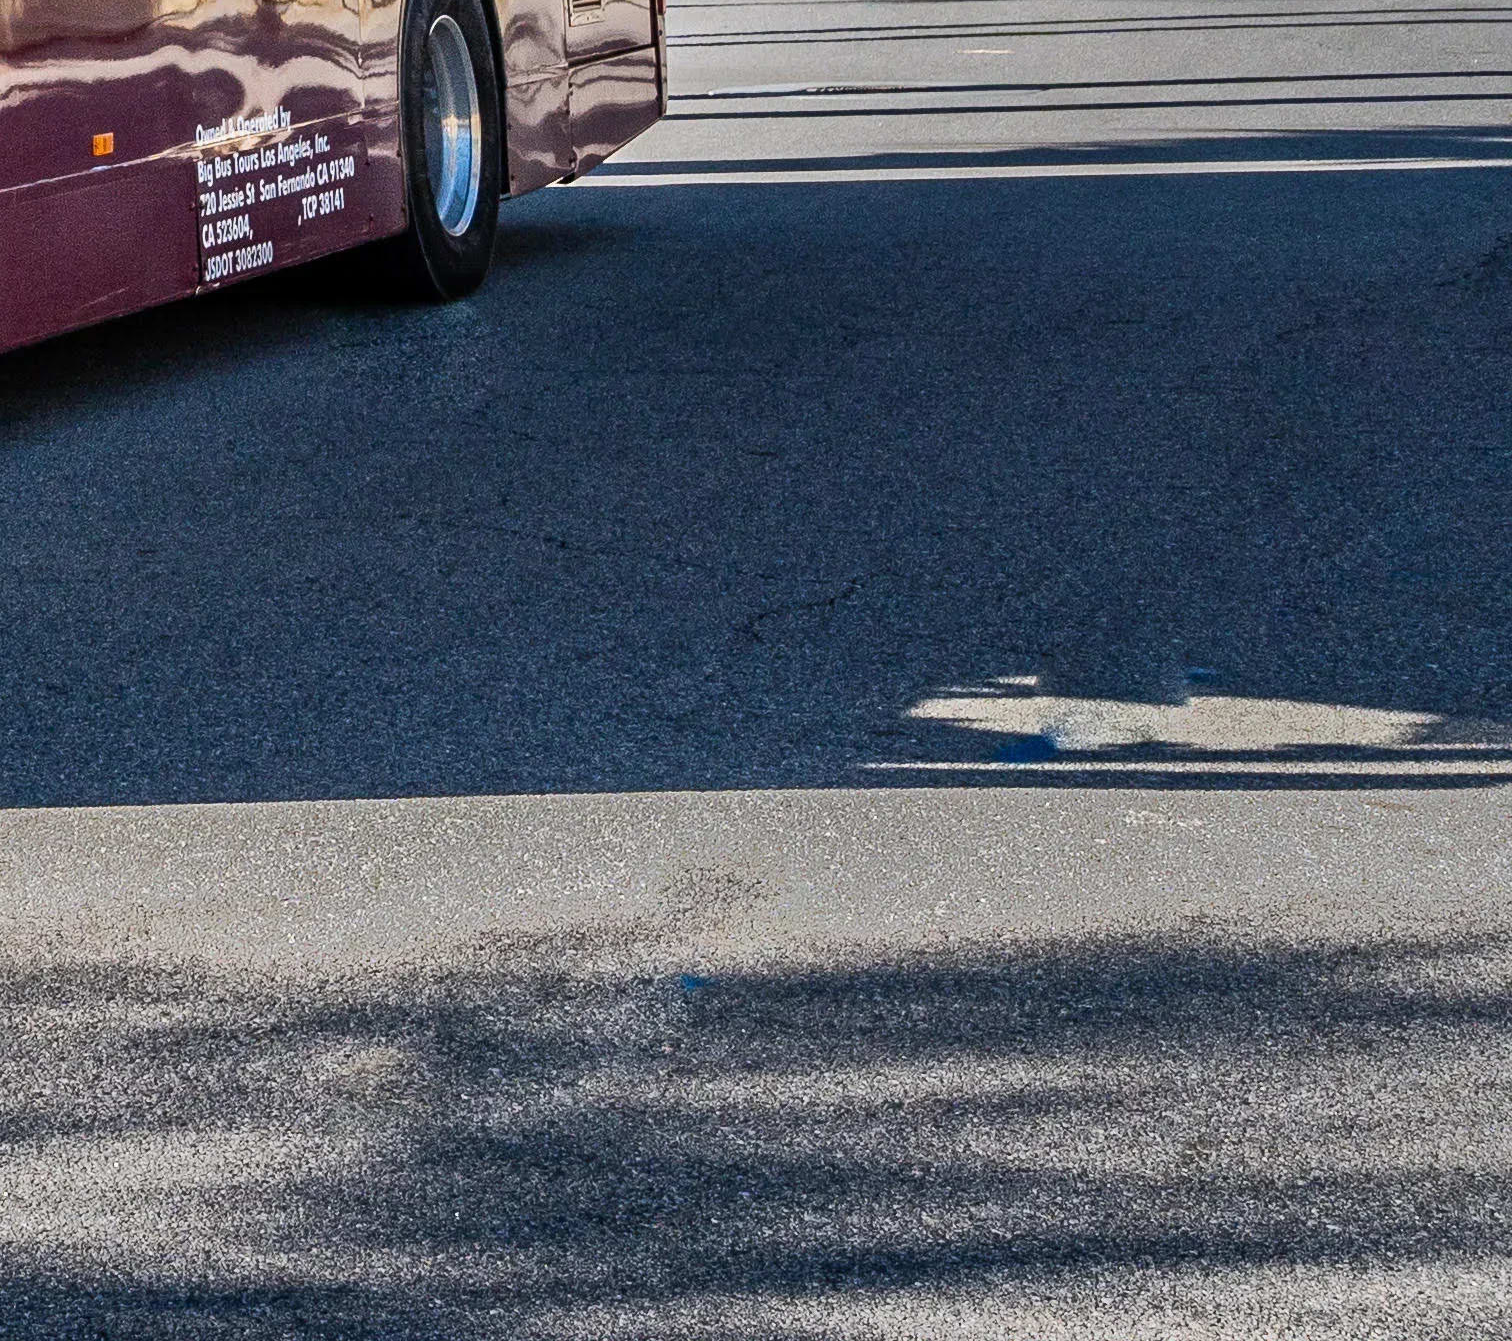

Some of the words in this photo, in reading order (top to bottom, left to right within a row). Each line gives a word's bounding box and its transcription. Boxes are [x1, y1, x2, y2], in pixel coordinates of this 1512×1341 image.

[195, 118, 225, 146] Owned
[280, 105, 292, 132] by
[197, 160, 214, 187] Big
[214, 156, 232, 180] Bus
[233, 151, 259, 175] Tours
[260, 147, 276, 168] Los
[277, 134, 314, 167] Angeles,
[315, 132, 331, 155] Inc.
[218, 188, 244, 213] Jessie
[246, 181, 256, 206] St
[259, 178, 276, 203] San
[277, 166, 315, 197] Fernando
[316, 162, 329, 186] CA
[329, 155, 355, 182] 91340
[202, 221, 215, 249] CA
[216, 213, 253, 245] 523604,
[318, 187, 345, 216] 38141
[235, 241, 274, 272] 3082300
